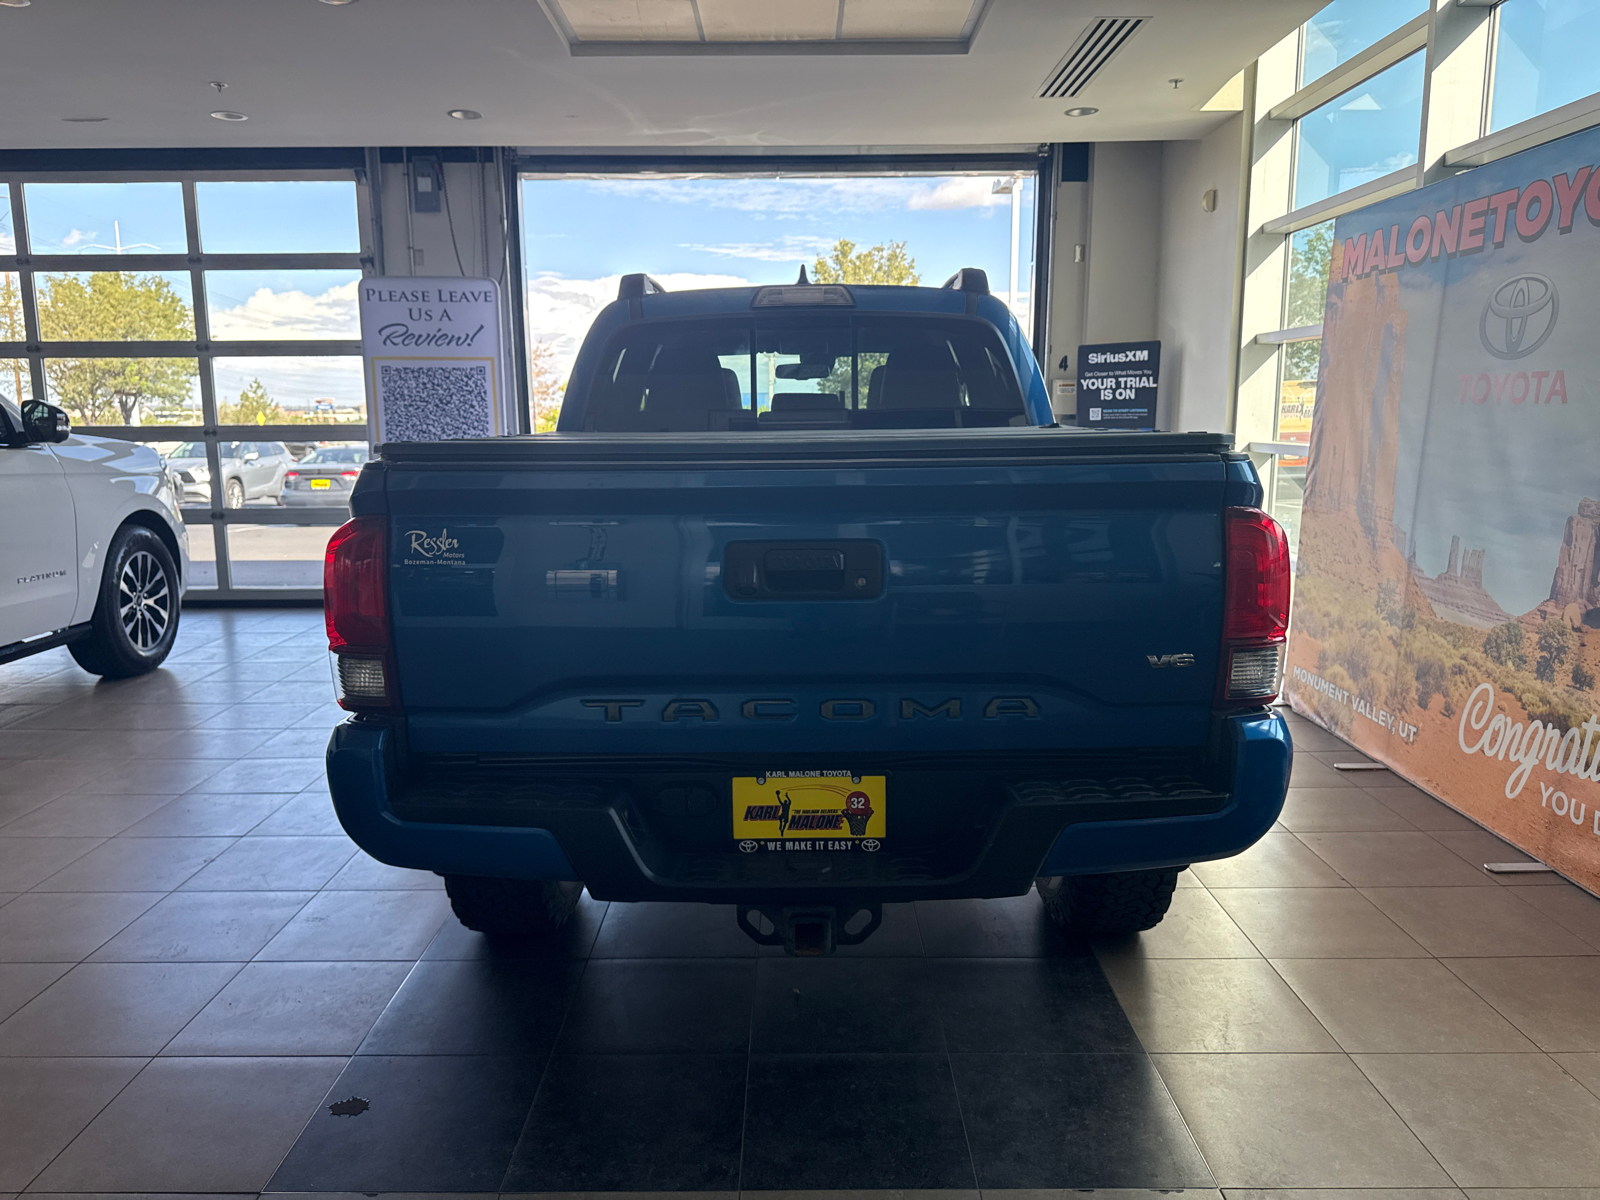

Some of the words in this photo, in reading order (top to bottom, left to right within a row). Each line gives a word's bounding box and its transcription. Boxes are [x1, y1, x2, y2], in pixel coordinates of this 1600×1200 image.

[365, 288, 430, 303] PLEASE
[438, 289, 493, 303] LEAVE
[439, 308, 453, 322] A
[378, 322, 484, 347] Review!
[1058, 355, 1069, 372] 4
[1088, 350, 1149, 364] SiriusXM
[1080, 378, 1116, 390] YOUR
[1118, 377, 1158, 389] TRIAL
[1457, 369, 1568, 405] TOYOTA
[1100, 390, 1113, 400] IS
[1115, 389, 1136, 400] ON
[1281, 405, 1300, 414] KARL
[404, 528, 460, 558] Ressler
[17, 570, 67, 584] PLATINUM
[1146, 653, 1195, 668] V6
[582, 697, 1042, 723] TACOMA
[1292, 665, 1349, 705] MONUMENT
[1351, 698, 1396, 735] VALLEY,
[1398, 719, 1417, 743] UT
[850, 797, 865, 809] 32
[1540, 781, 1586, 825] YOU
[743, 805, 781, 821] KARL
[787, 814, 844, 830] MALONE
[767, 842, 782, 851] WE
[785, 841, 812, 850] MAKE
[816, 841, 825, 850] IT
[828, 841, 852, 850] EASY
